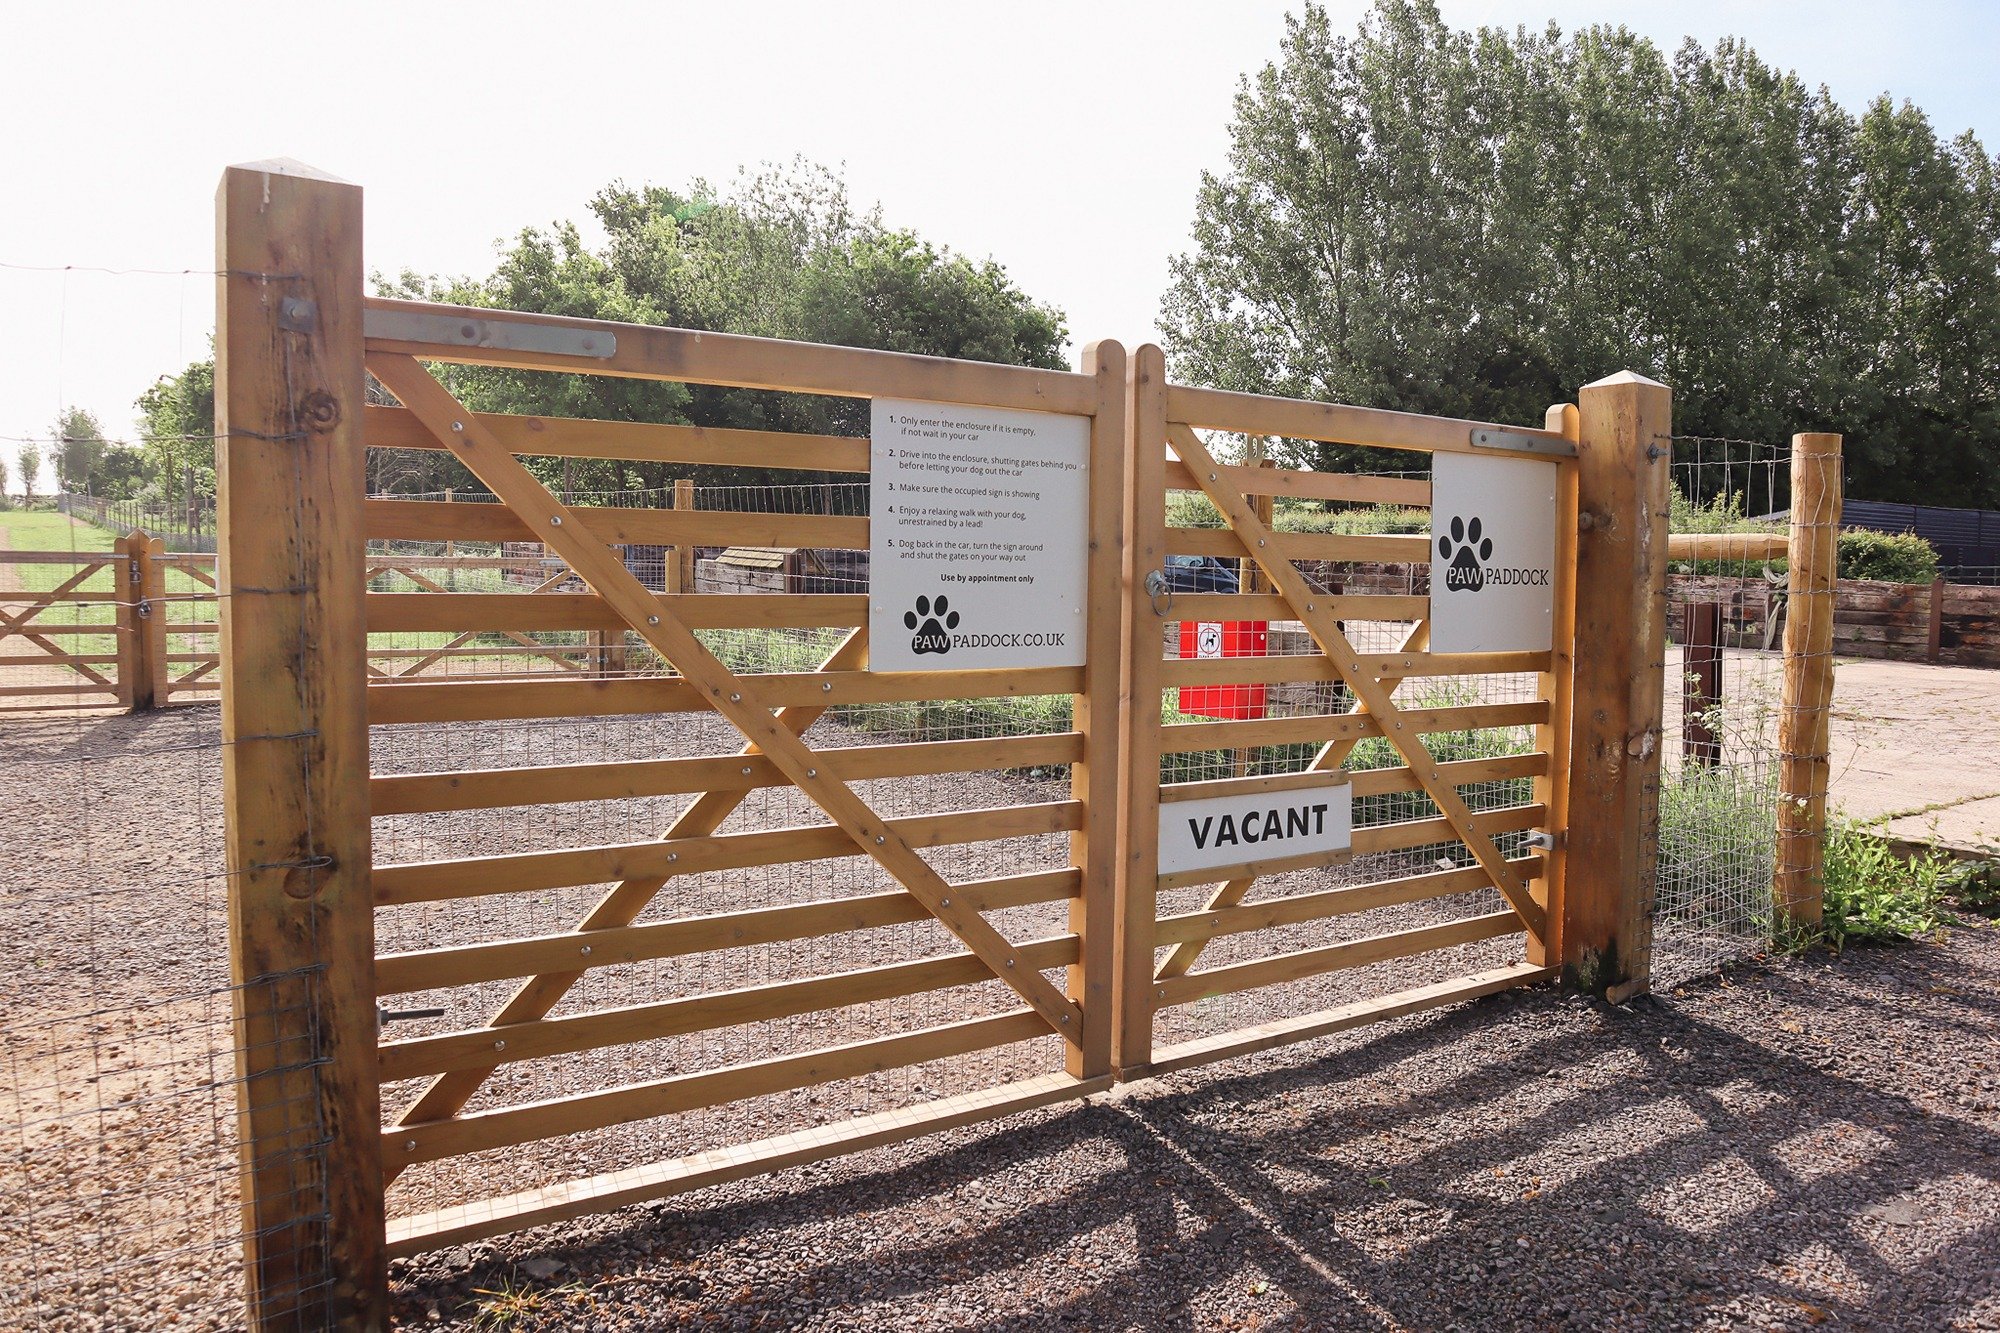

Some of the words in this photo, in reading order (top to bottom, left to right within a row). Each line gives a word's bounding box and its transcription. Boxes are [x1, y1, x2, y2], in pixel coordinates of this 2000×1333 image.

[900, 416, 918, 427] Only
[942, 420, 954, 428] the
[956, 422, 990, 431] enclosure
[900, 450, 920, 458] Drive
[922, 451, 936, 460] into
[991, 456, 1020, 468] shutting
[1021, 460, 1039, 468] gates
[1041, 460, 1063, 469] behind
[899, 461, 924, 470] before
[926, 463, 950, 474] letting
[970, 466, 983, 476] dog
[900, 484, 920, 492] Make
[955, 488, 986, 496] occupied
[989, 489, 1002, 498] sign
[1012, 490, 1040, 500] showing
[900, 506, 920, 516] Enjoy
[928, 508, 958, 518] relaxing
[949, 519, 958, 529] by
[899, 540, 914, 550] Dog
[917, 540, 934, 548] back
[1003, 543, 1017, 552] sign
[949, 554, 968, 562] gates
[957, 574, 966, 583] by
[968, 574, 1016, 583] appointment
[1018, 575, 1034, 584] only
[1448, 567, 1482, 584] PAW
[1486, 568, 1549, 585] PADDOCK
[914, 635, 949, 649] PAW
[953, 634, 1064, 648] PADDOCK.CO.UK
[1188, 804, 1327, 849] VACANT
